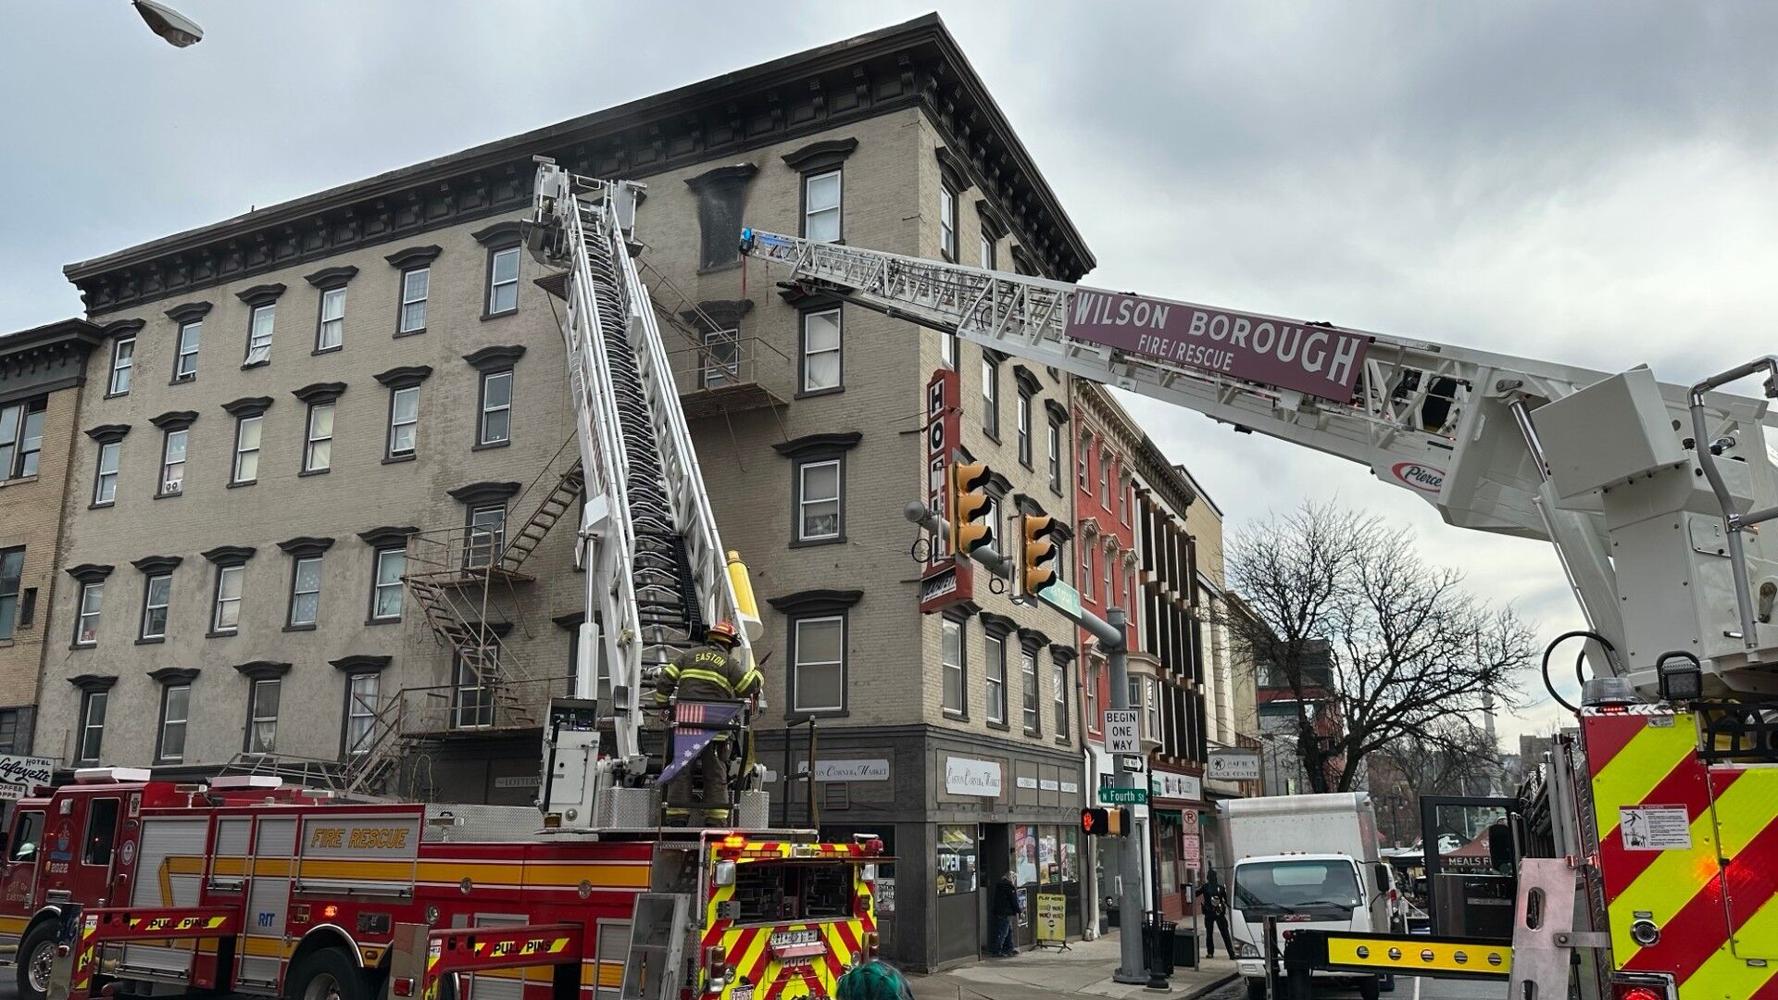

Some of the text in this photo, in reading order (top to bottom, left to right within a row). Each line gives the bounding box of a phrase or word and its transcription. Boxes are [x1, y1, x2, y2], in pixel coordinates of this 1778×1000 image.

[1074, 291, 1361, 387] WILSON BOROUGH
[1137, 334, 1234, 371] FIRE/RESCUE
[1404, 466, 1442, 487] Pierce
[695, 652, 726, 667] EASTON
[1107, 713, 1136, 723] BEGIN
[1112, 727, 1132, 737] ONE
[1113, 740, 1133, 750] WAY
[26, 758, 51, 766] HOTEL
[0, 757, 51, 783] Lafayette
[1102, 793, 1107, 801] N
[1110, 790, 1136, 801] Fourth
[310, 828, 410, 849] FIRE RESCUE
[50, 863, 68, 873] 2022
[941, 853, 960, 872] OPEN
[1448, 857, 1481, 866] MEALS
[150, 917, 209, 929] PULL PINS
[258, 912, 276, 928] RIT
[494, 940, 551, 955] PULL PINS
